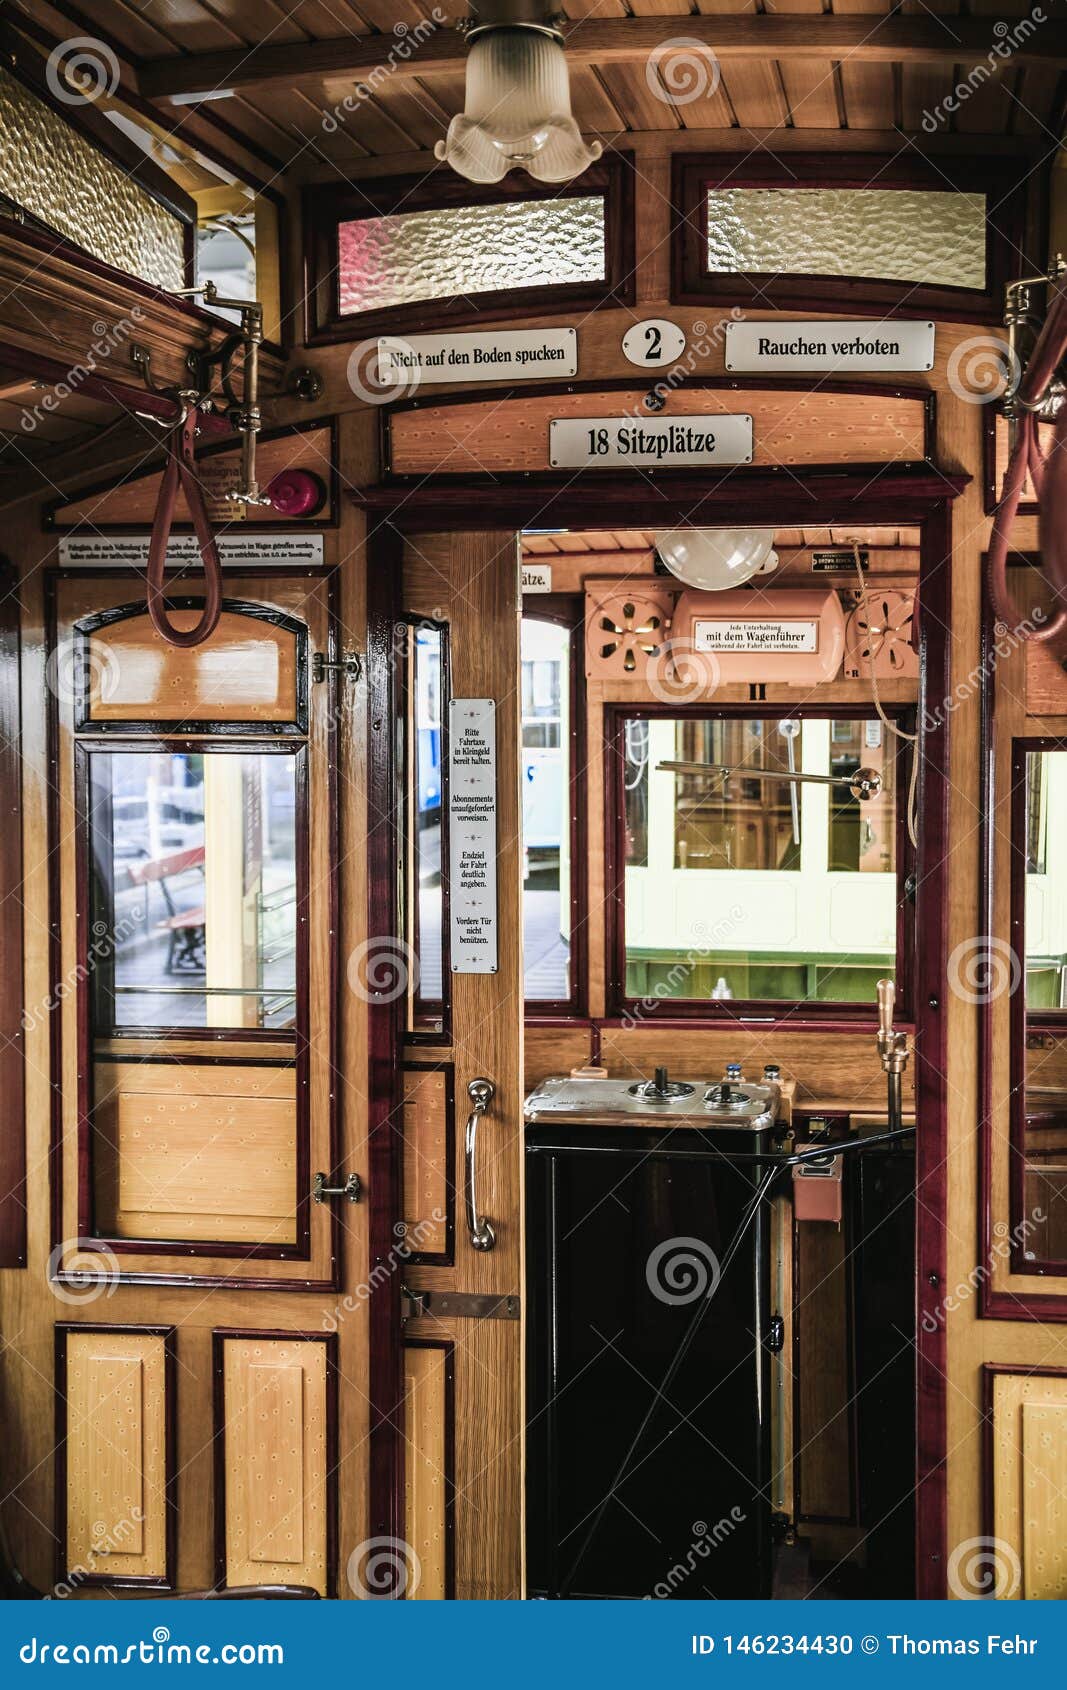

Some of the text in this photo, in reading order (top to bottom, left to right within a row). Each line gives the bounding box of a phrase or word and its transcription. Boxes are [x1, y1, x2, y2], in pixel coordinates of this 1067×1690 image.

[645, 327, 662, 360] 2
[757, 336, 900, 355] Rauchen verboten
[390, 344, 566, 368] Nicht auf den Boden spucken
[587, 425, 716, 459] 18 Sitzplätze
[706, 631, 806, 642] mit dem Wagenführer
[464, 728, 480, 737] Bitte
[458, 738, 486, 747] Fahrtaxe
[454, 747, 490, 758] in Kleingeld
[452, 757, 492, 766] bereit halten.
[452, 794, 494, 804] Abonnemente
[451, 804, 495, 813] unaufgefordert
[462, 851, 485, 860] Endziel
[460, 861, 488, 869] der Fahrt
[461, 870, 486, 878] deutlich
[460, 880, 487, 889] angeben.
[456, 916, 492, 926] Vordere Tür
[466, 927, 482, 935] nicht
[459, 936, 489, 944] benützen.
